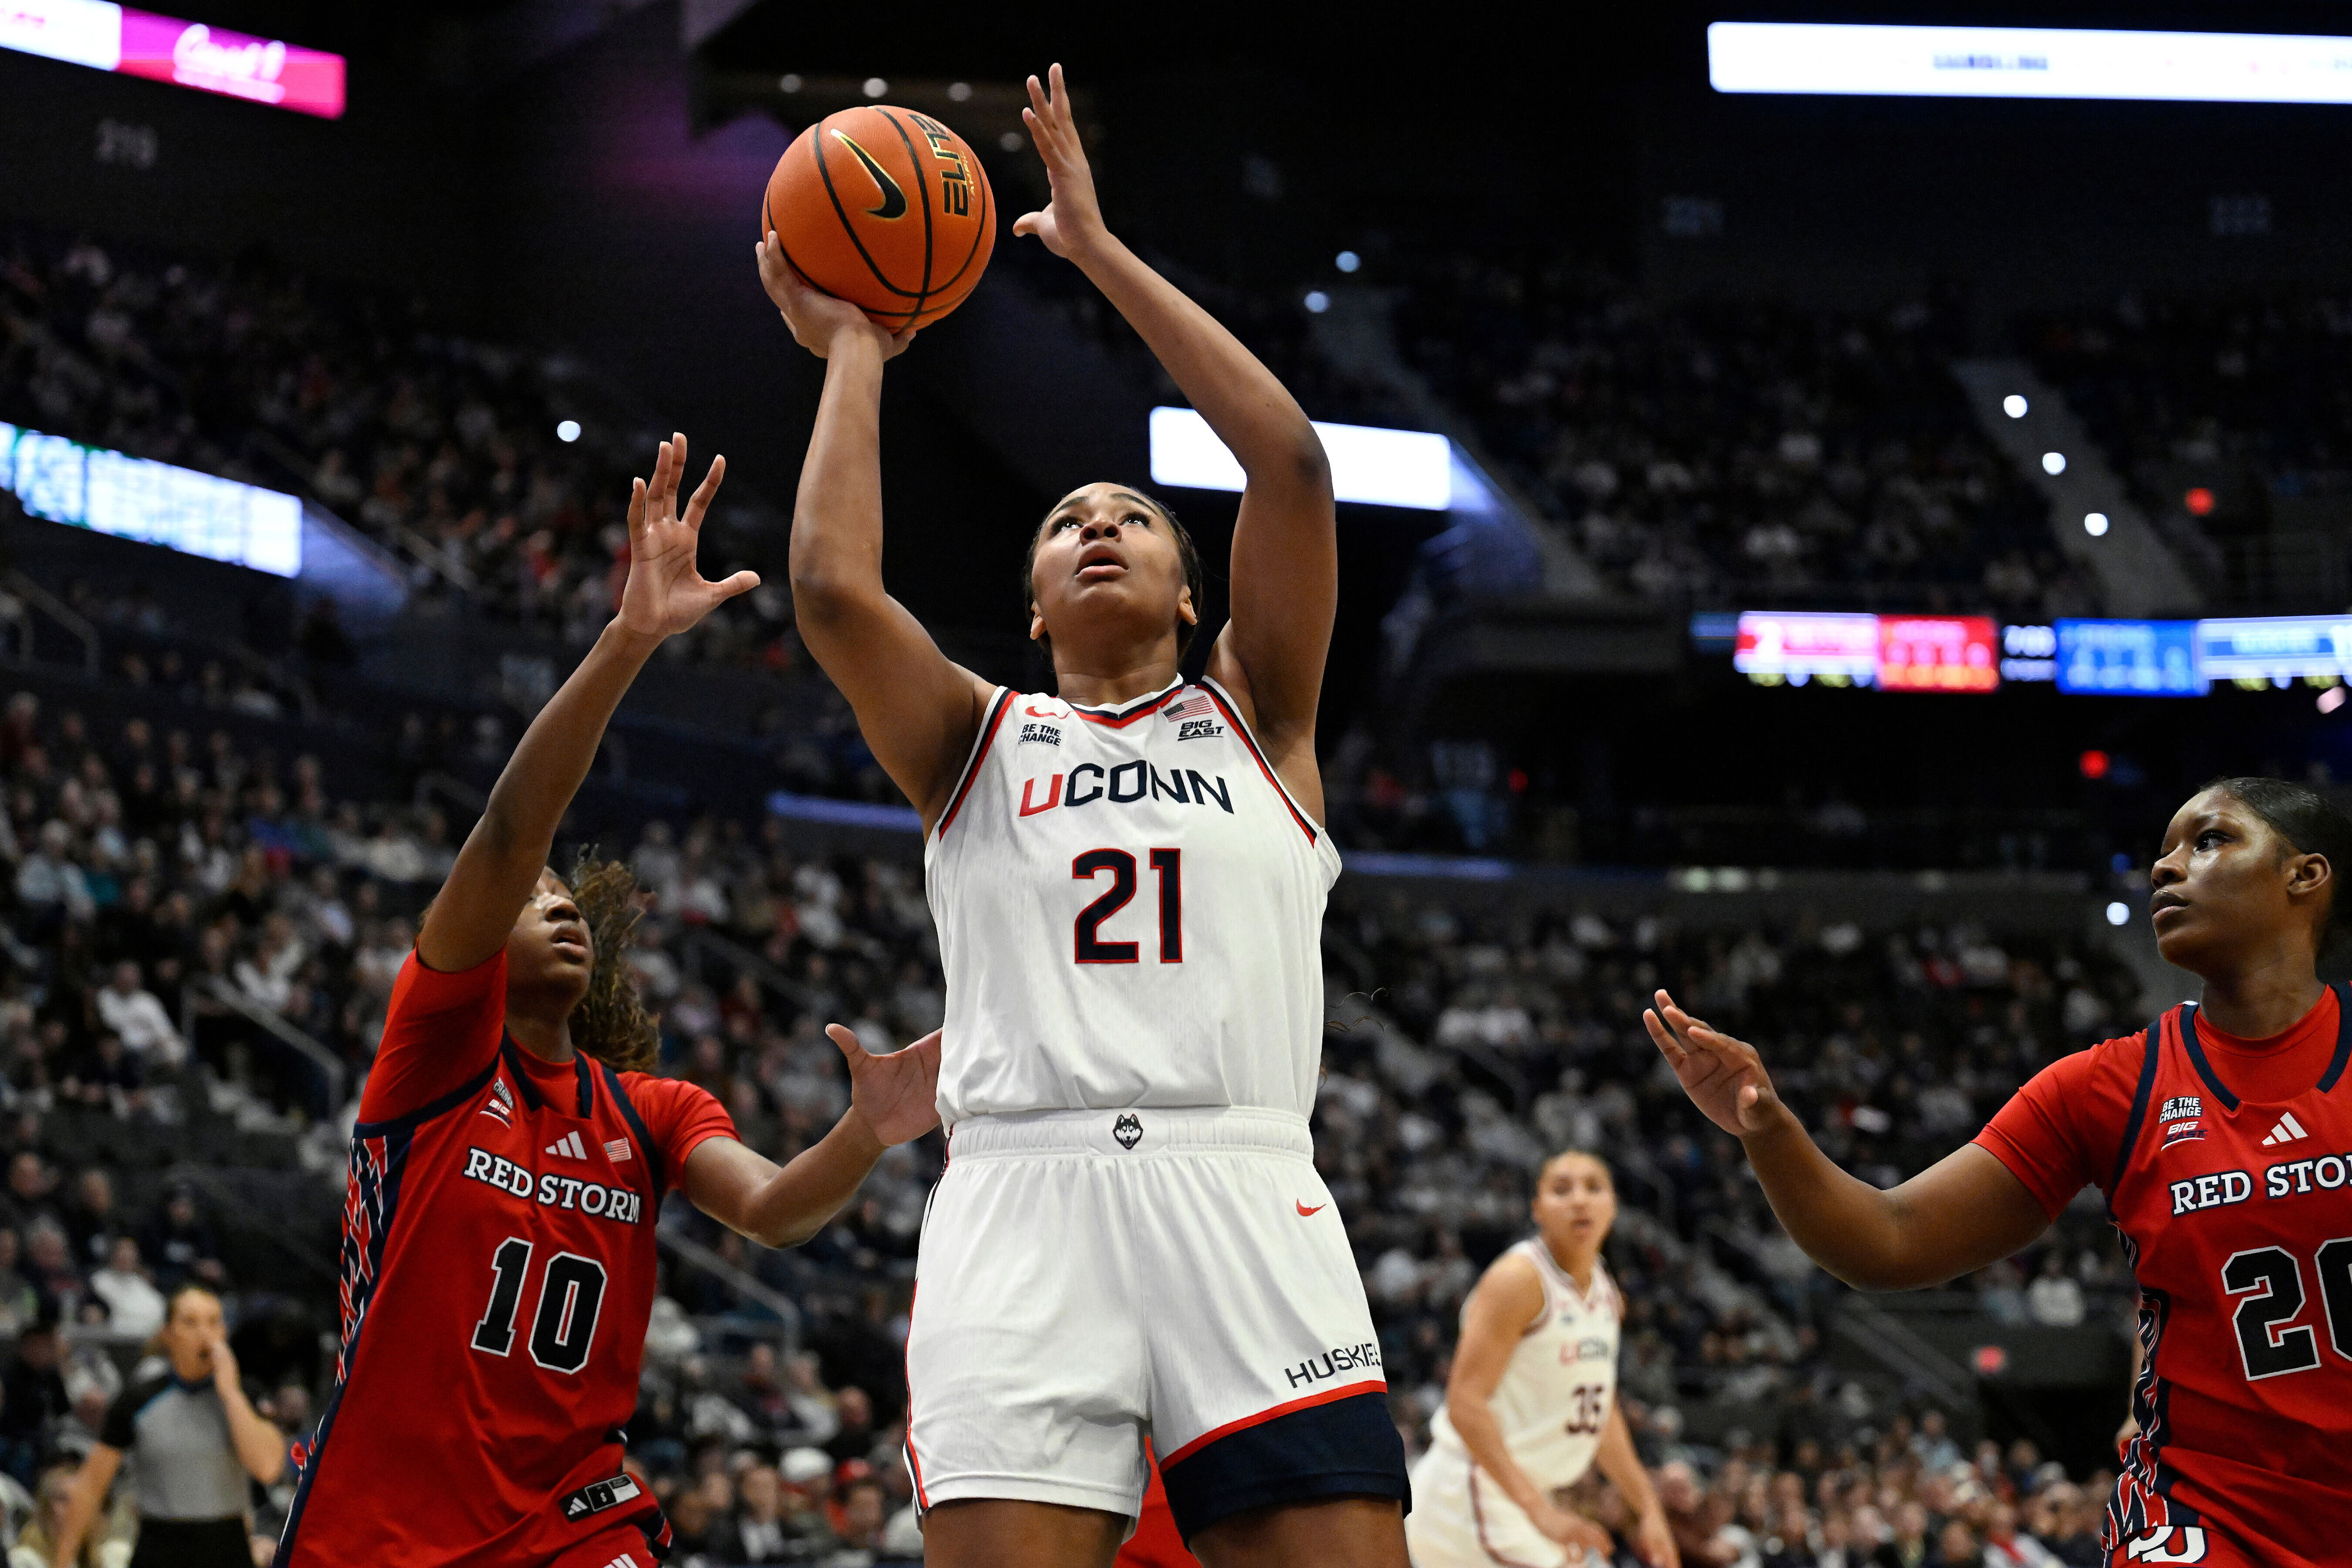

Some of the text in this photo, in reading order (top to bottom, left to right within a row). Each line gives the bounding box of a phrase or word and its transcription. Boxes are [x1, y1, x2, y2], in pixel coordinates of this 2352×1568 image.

[908, 114, 969, 217] ELITE
[1022, 724, 1061, 737] BE THE
[1179, 726, 1224, 737] EAST
[1180, 719, 1212, 730] BIG
[1018, 733, 1061, 747] CHANGE
[1019, 759, 1234, 817] UCONN
[1072, 848, 1183, 964] 21
[489, 1099, 510, 1116] BIG
[2162, 1097, 2200, 1113] BE THE
[2159, 1107, 2202, 1124] CHANGE
[2167, 1121, 2199, 1135] BIG
[2164, 1130, 2208, 1145] EAST
[464, 1147, 640, 1224] RED STORM
[2170, 1154, 2352, 1216] RED STO
[471, 1236, 608, 1375] 10
